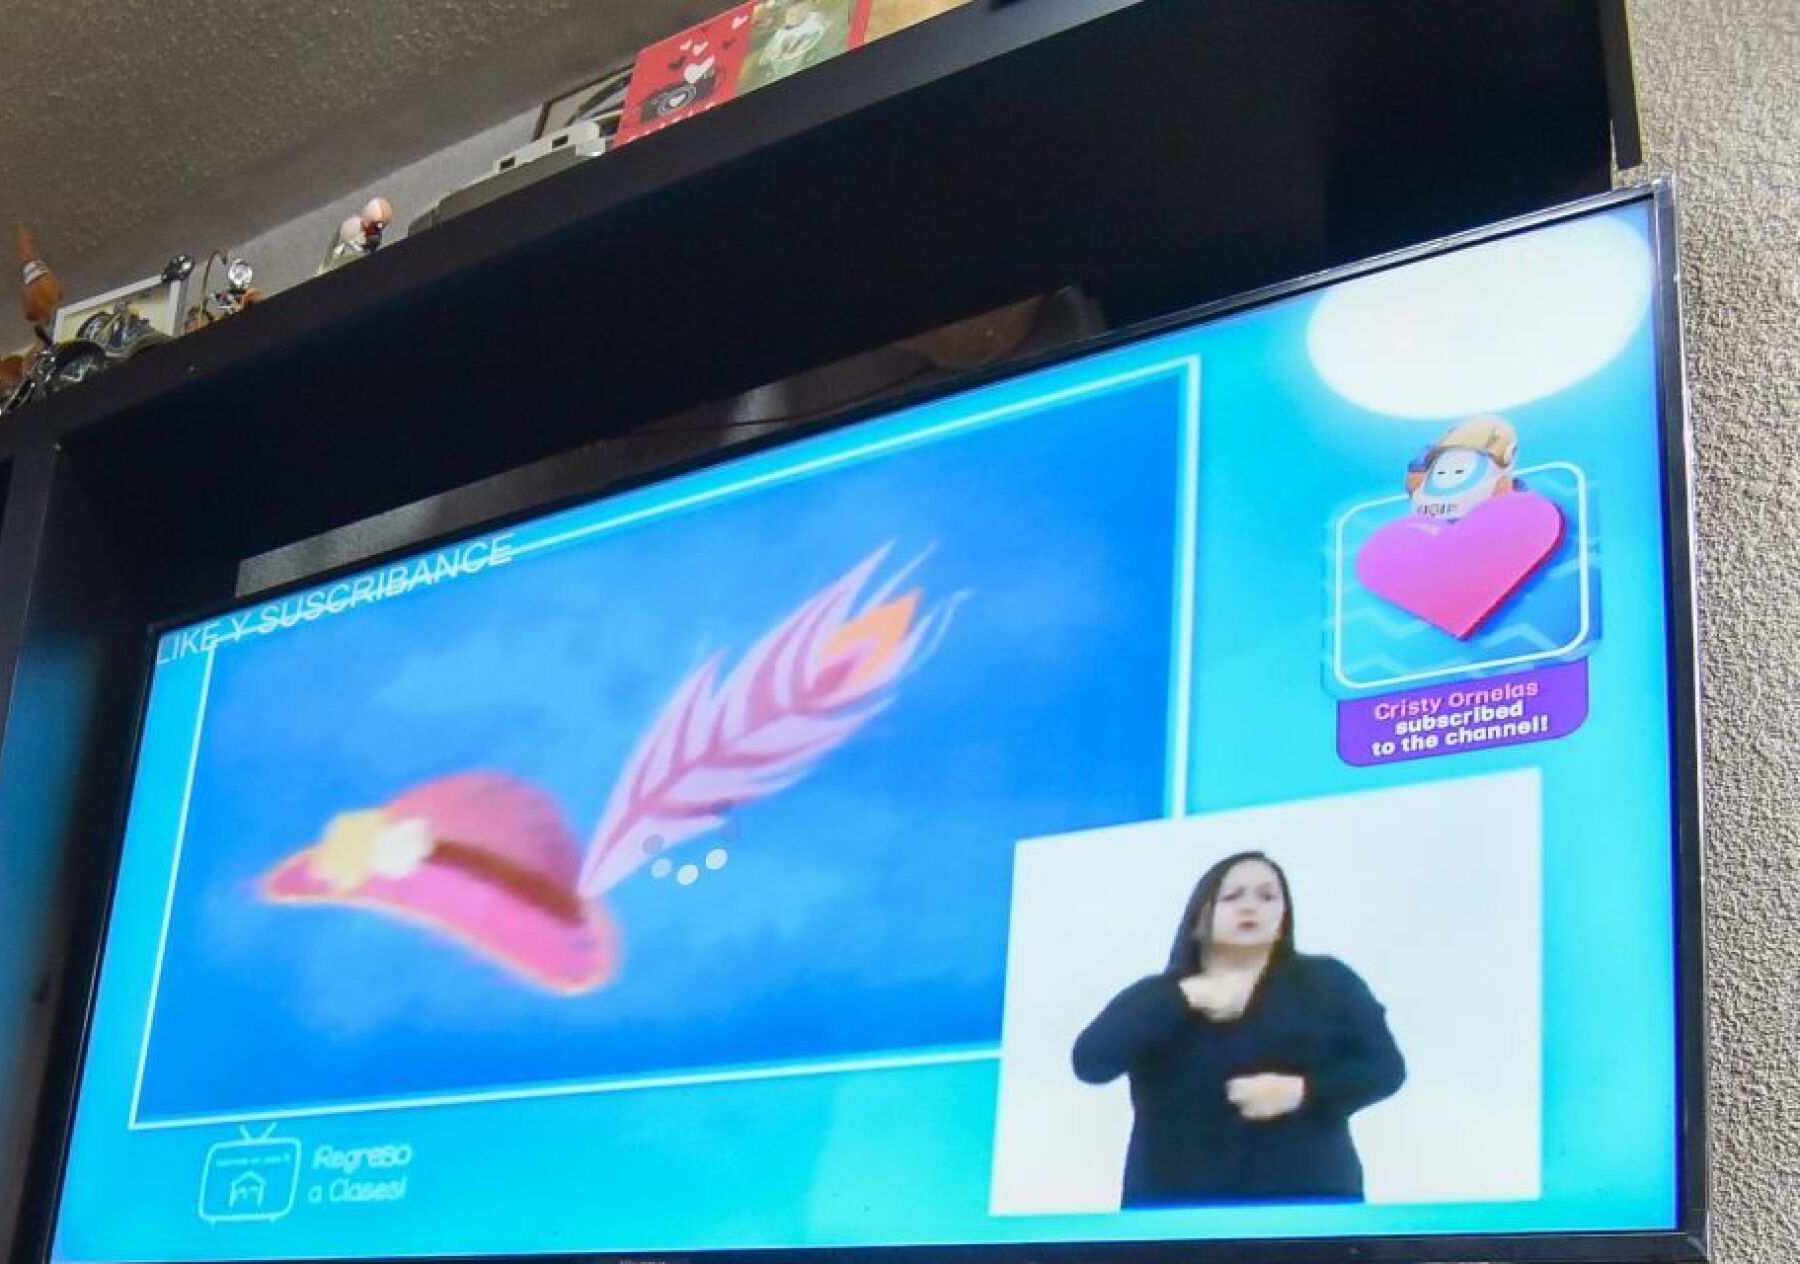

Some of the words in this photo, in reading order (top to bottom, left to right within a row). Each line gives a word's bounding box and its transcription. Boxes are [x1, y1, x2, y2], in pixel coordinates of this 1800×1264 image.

[157, 620, 221, 665] LIKE
[231, 608, 251, 642] Y
[258, 532, 515, 635] SUSCRIBANCE
[1374, 696, 1441, 721] Cristy
[1448, 681, 1538, 708] Ornelas
[1395, 700, 1523, 736] subscribed
[1371, 740, 1396, 758] to
[1402, 732, 1439, 753] the
[1444, 714, 1549, 747] channel!
